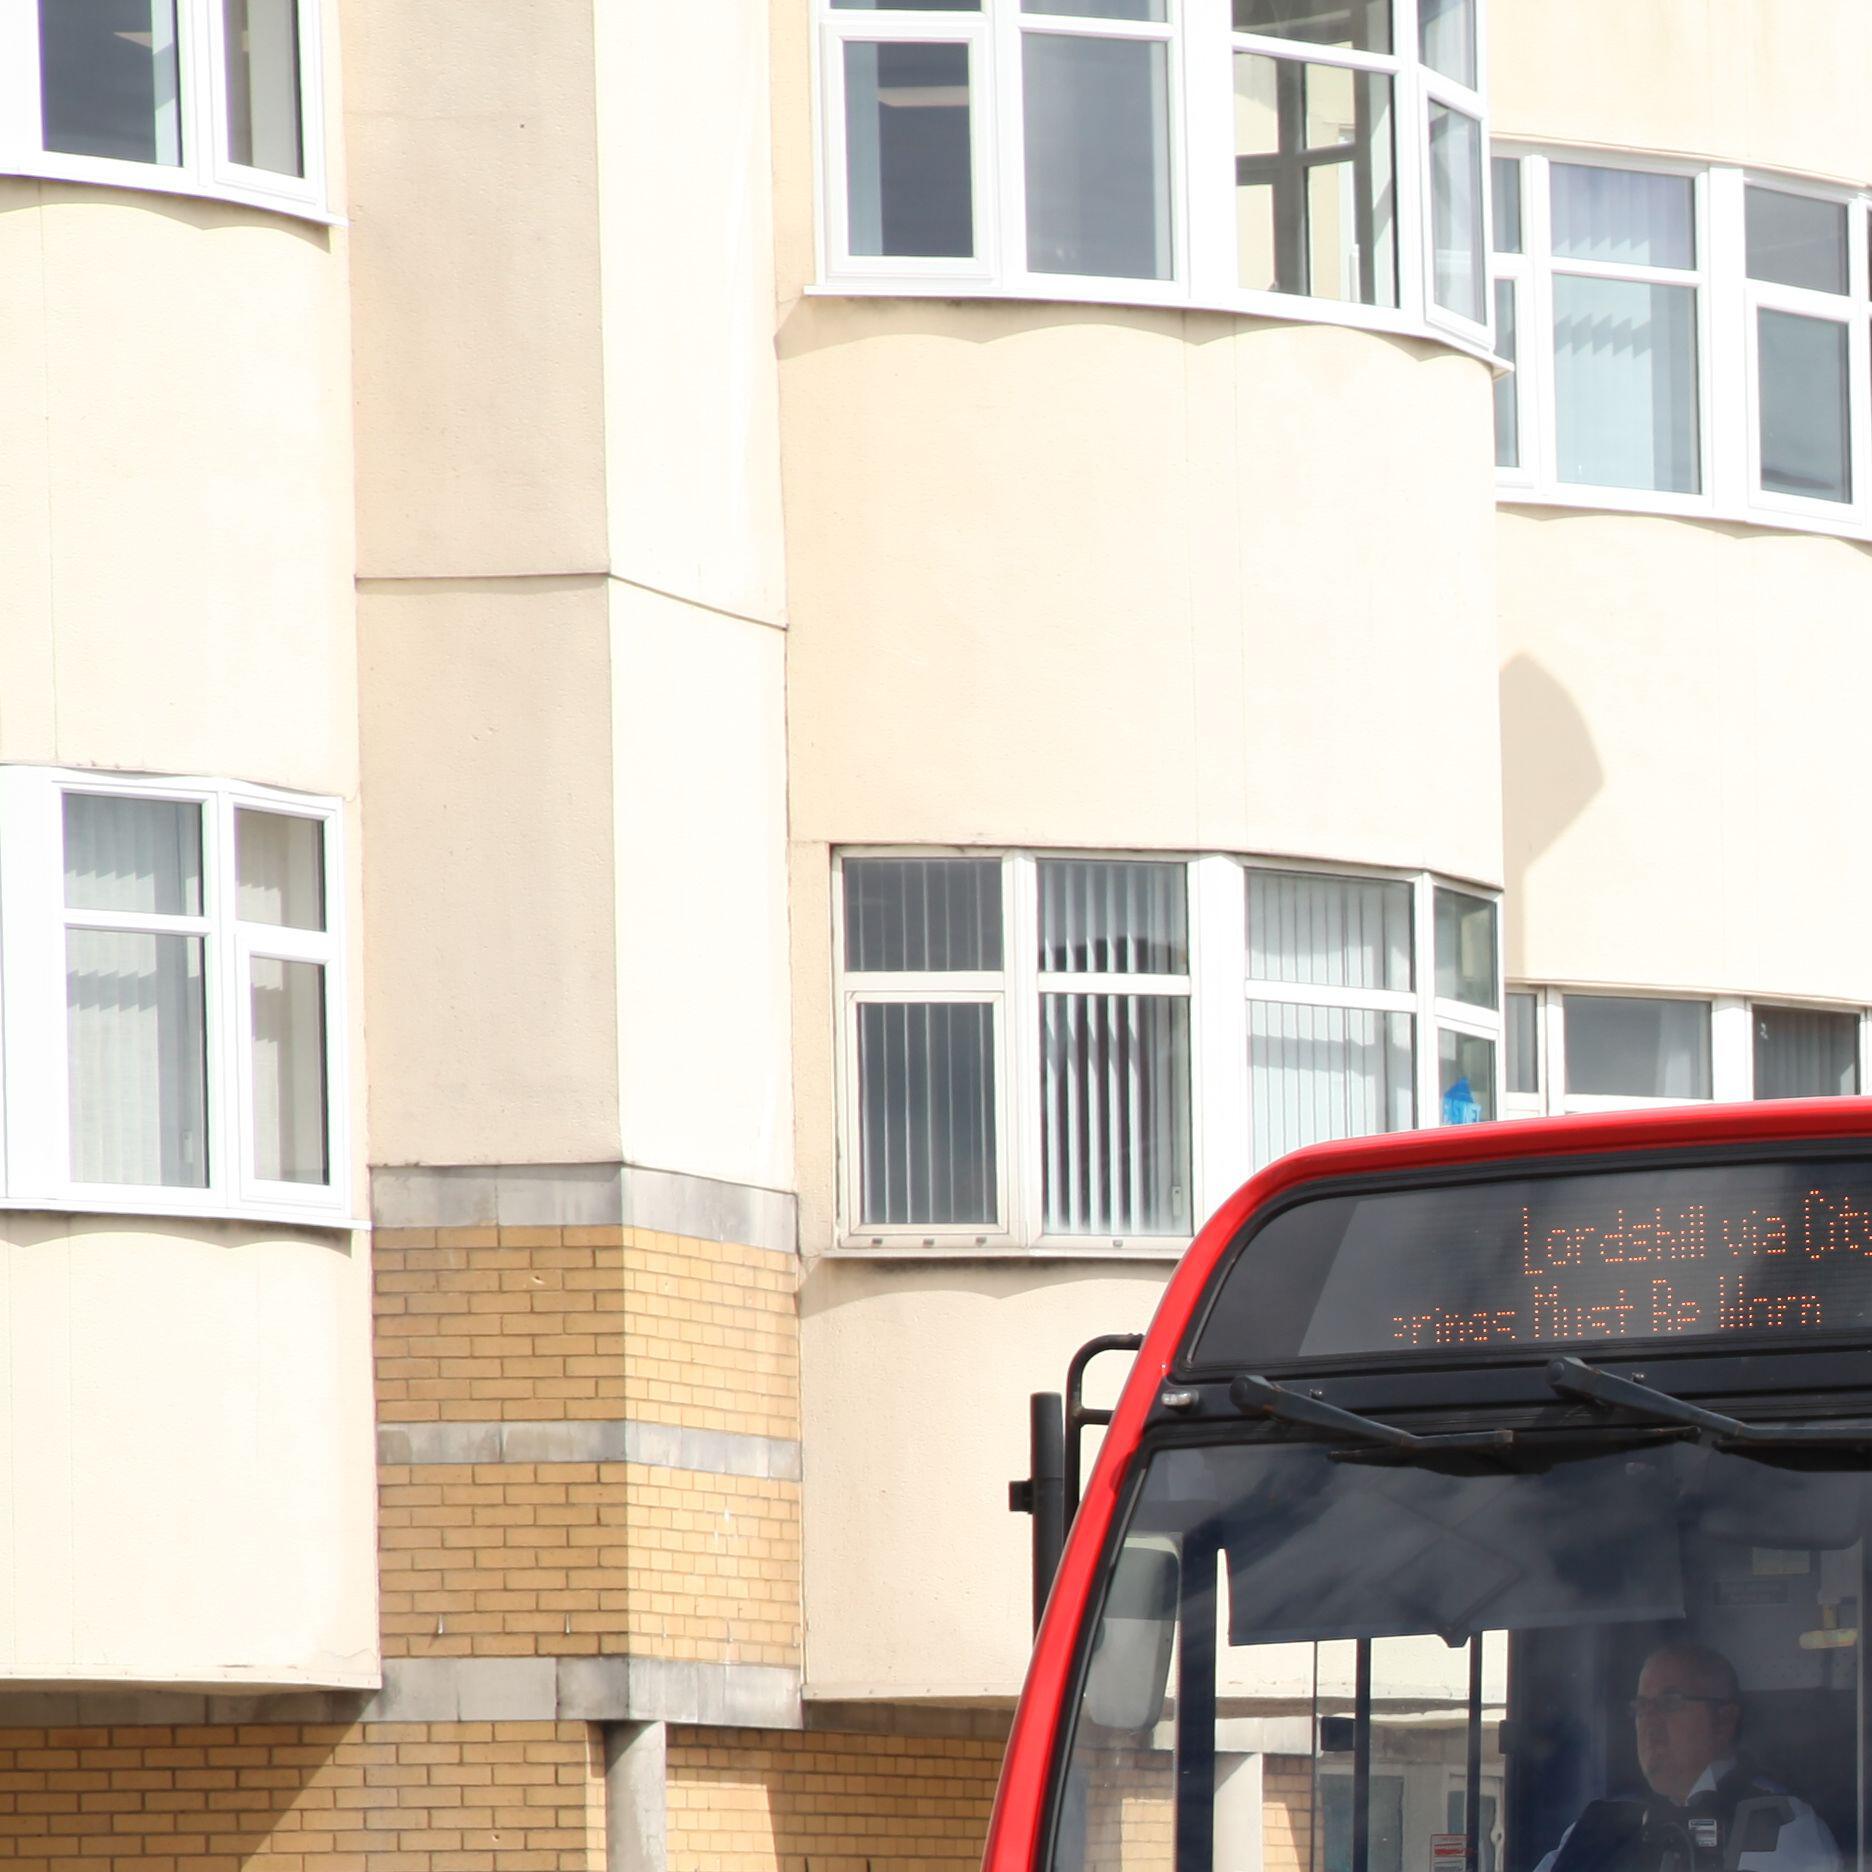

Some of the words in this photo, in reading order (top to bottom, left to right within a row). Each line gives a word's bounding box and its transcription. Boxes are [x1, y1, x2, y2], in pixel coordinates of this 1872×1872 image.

[1522, 1205, 1704, 1275] Lordshill
[1723, 1209, 1787, 1256] via
[1533, 1285, 1635, 1338] Must
[1652, 1279, 1701, 1332] Be
